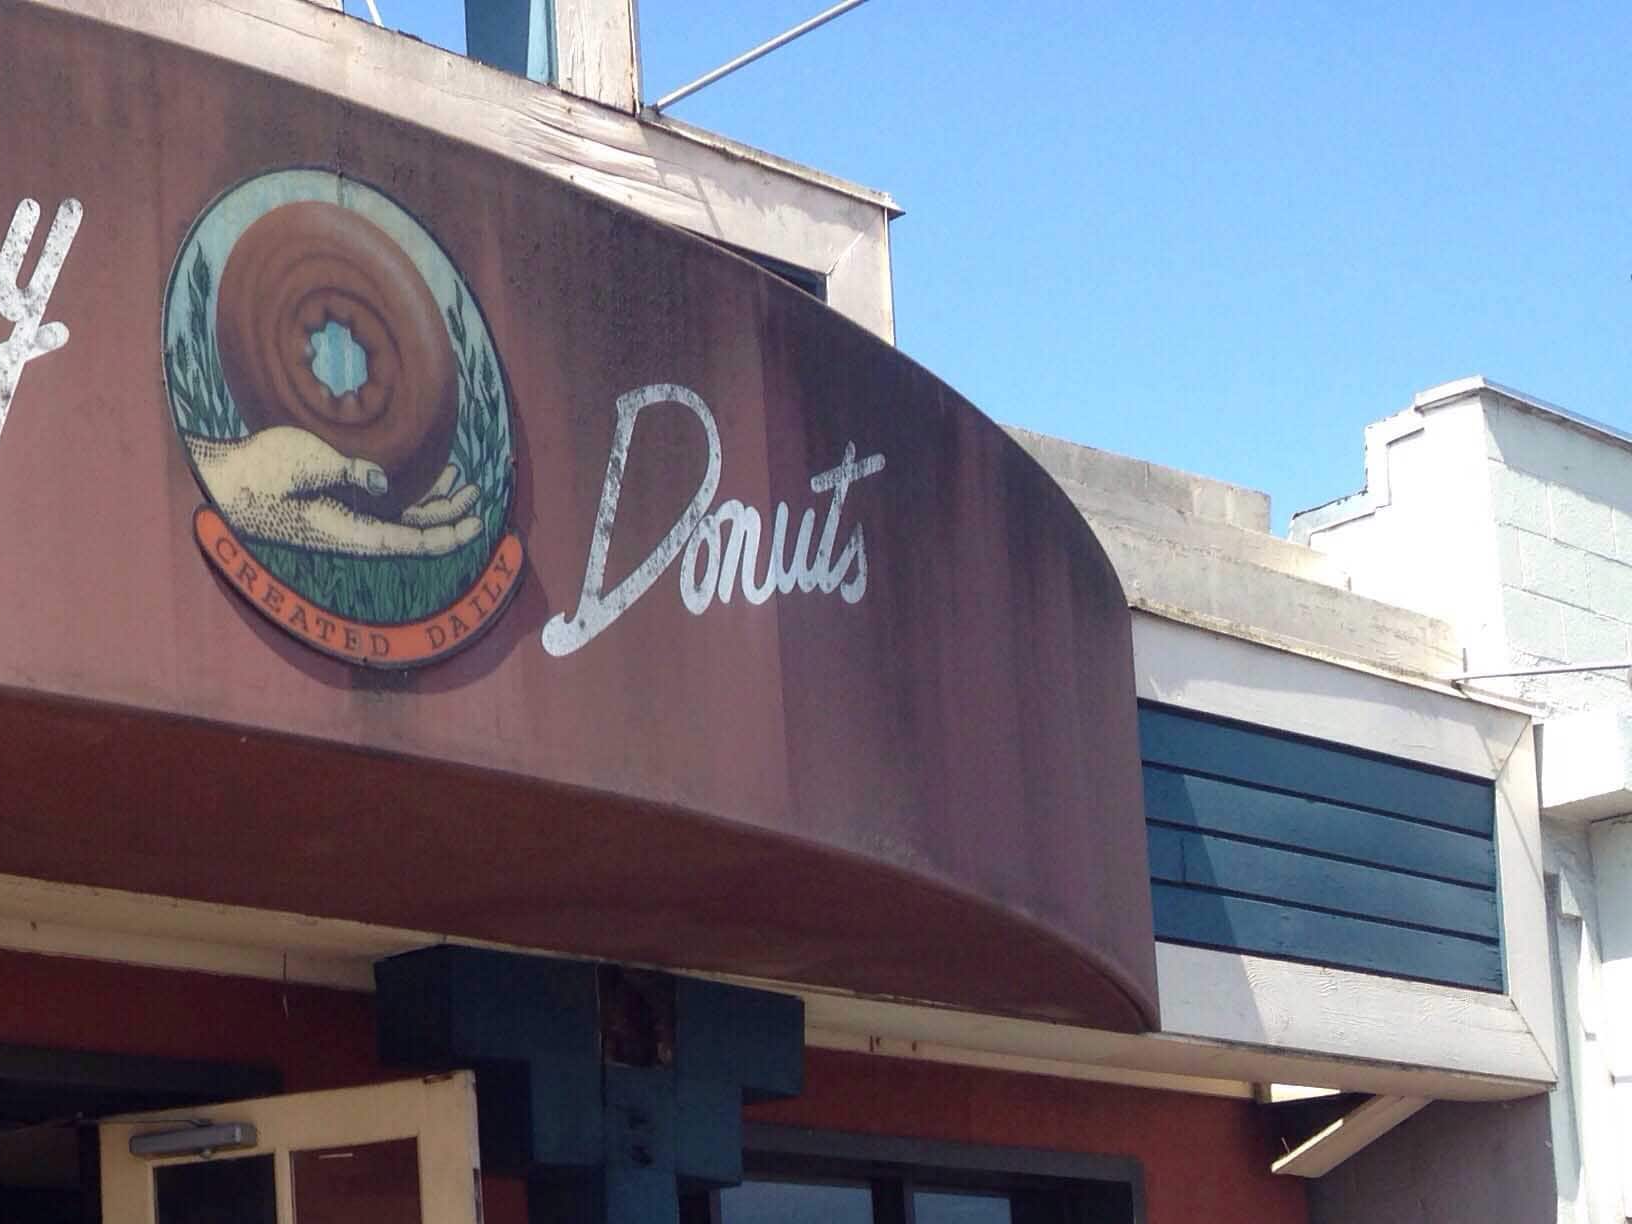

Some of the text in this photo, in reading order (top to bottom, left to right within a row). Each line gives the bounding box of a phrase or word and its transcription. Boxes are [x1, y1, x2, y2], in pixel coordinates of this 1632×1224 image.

[215, 536, 515, 657] CREATED DAILY
[541, 383, 886, 657] Donuts
